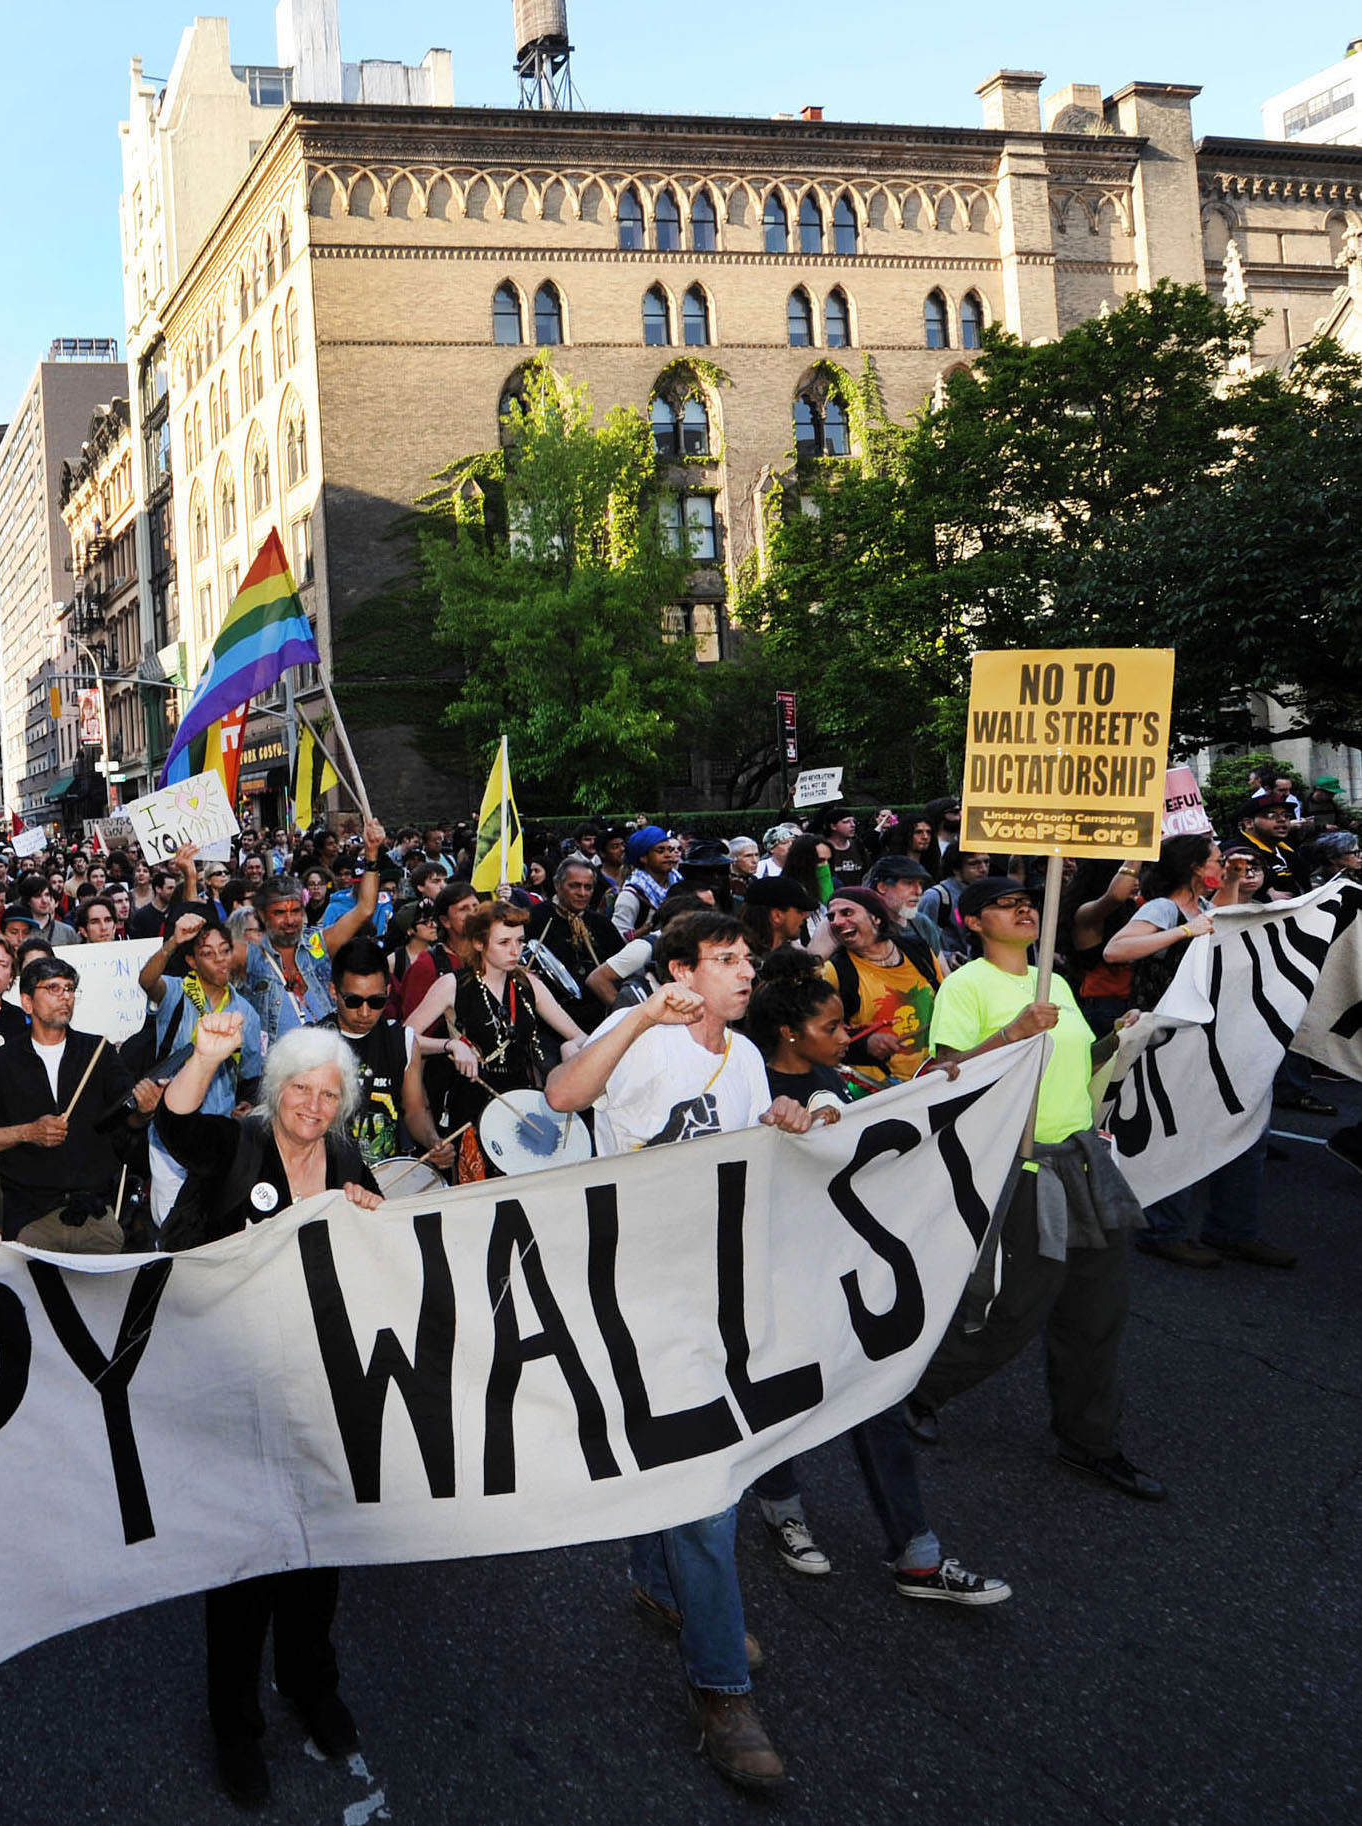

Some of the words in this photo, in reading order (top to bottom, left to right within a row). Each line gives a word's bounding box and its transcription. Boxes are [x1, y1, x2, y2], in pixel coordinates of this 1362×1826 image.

[1019, 663, 1065, 706] NO
[1074, 662, 1116, 706] TO
[973, 711, 1037, 744] WALL
[1044, 711, 1160, 747] STREET'S
[970, 754, 1156, 797] DICTATORSHIP
[981, 821, 1139, 846] VotePSL.org
[983, 811, 1073, 823] Lindsay/Osorio
[1075, 813, 1136, 825] Campaign
[298, 1160, 824, 1504] WALL
